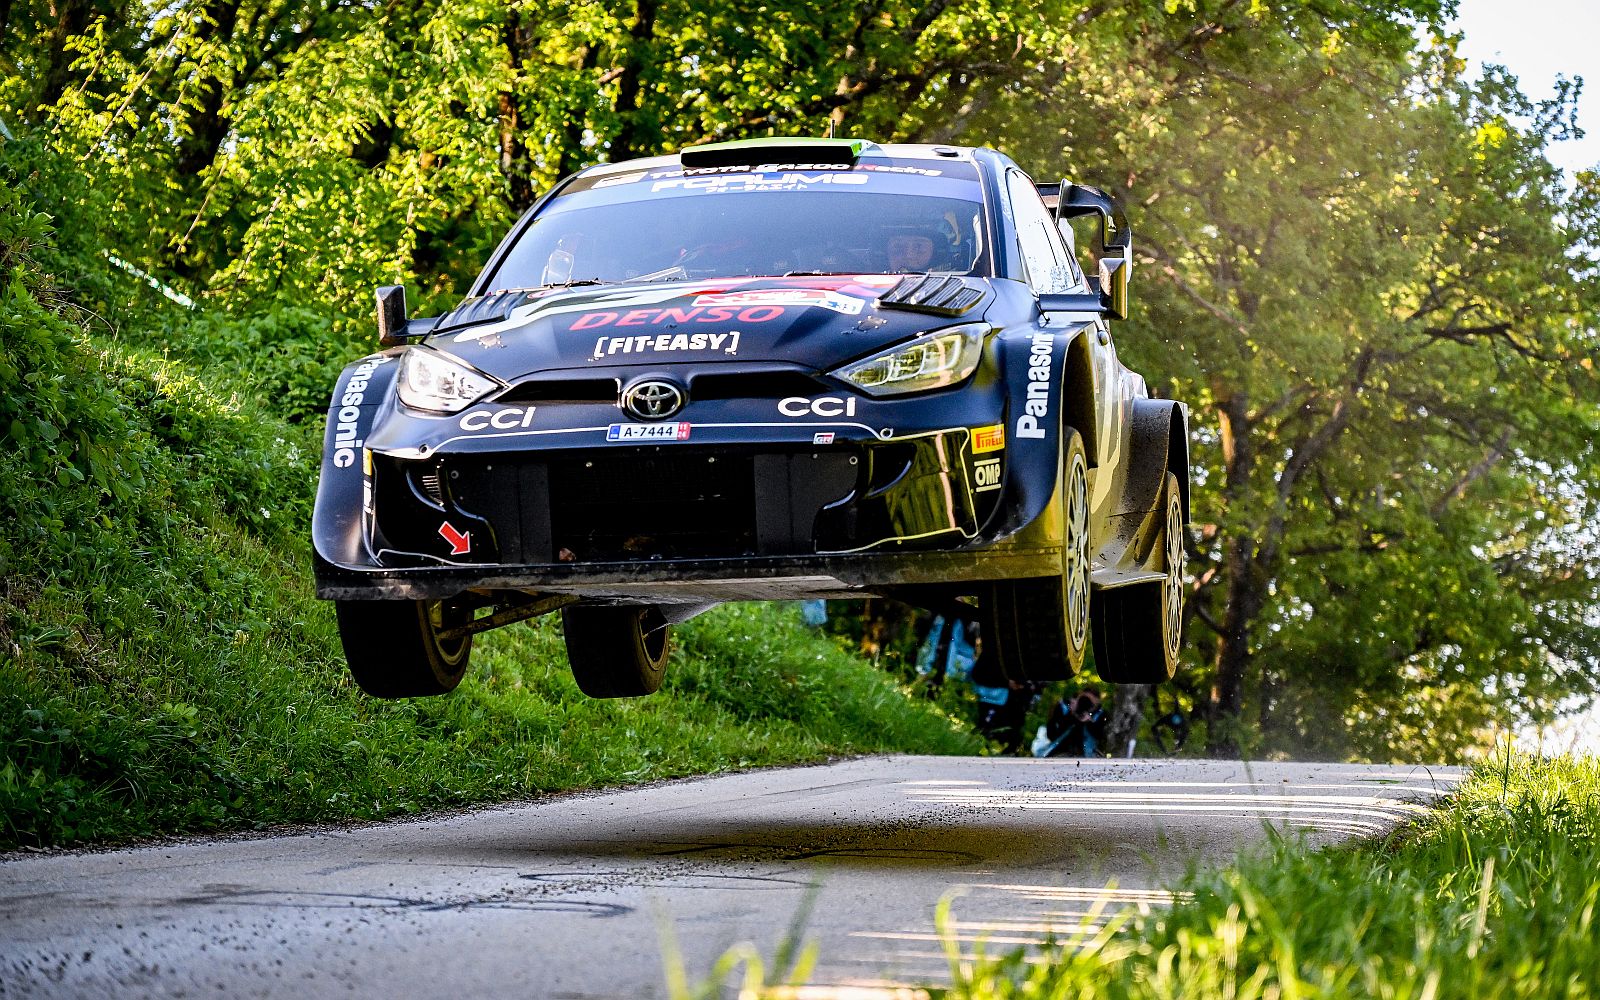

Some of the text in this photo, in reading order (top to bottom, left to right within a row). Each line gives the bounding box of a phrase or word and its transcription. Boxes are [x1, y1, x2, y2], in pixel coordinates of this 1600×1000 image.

[650, 163, 942, 179] TOYOTA GAZOO Racing
[569, 305, 785, 331] DENSO
[776, 396, 856, 417] CCI
[459, 406, 536, 431] CCI
[624, 426, 673, 437] A-7444
[975, 464, 1000, 486] OMP
